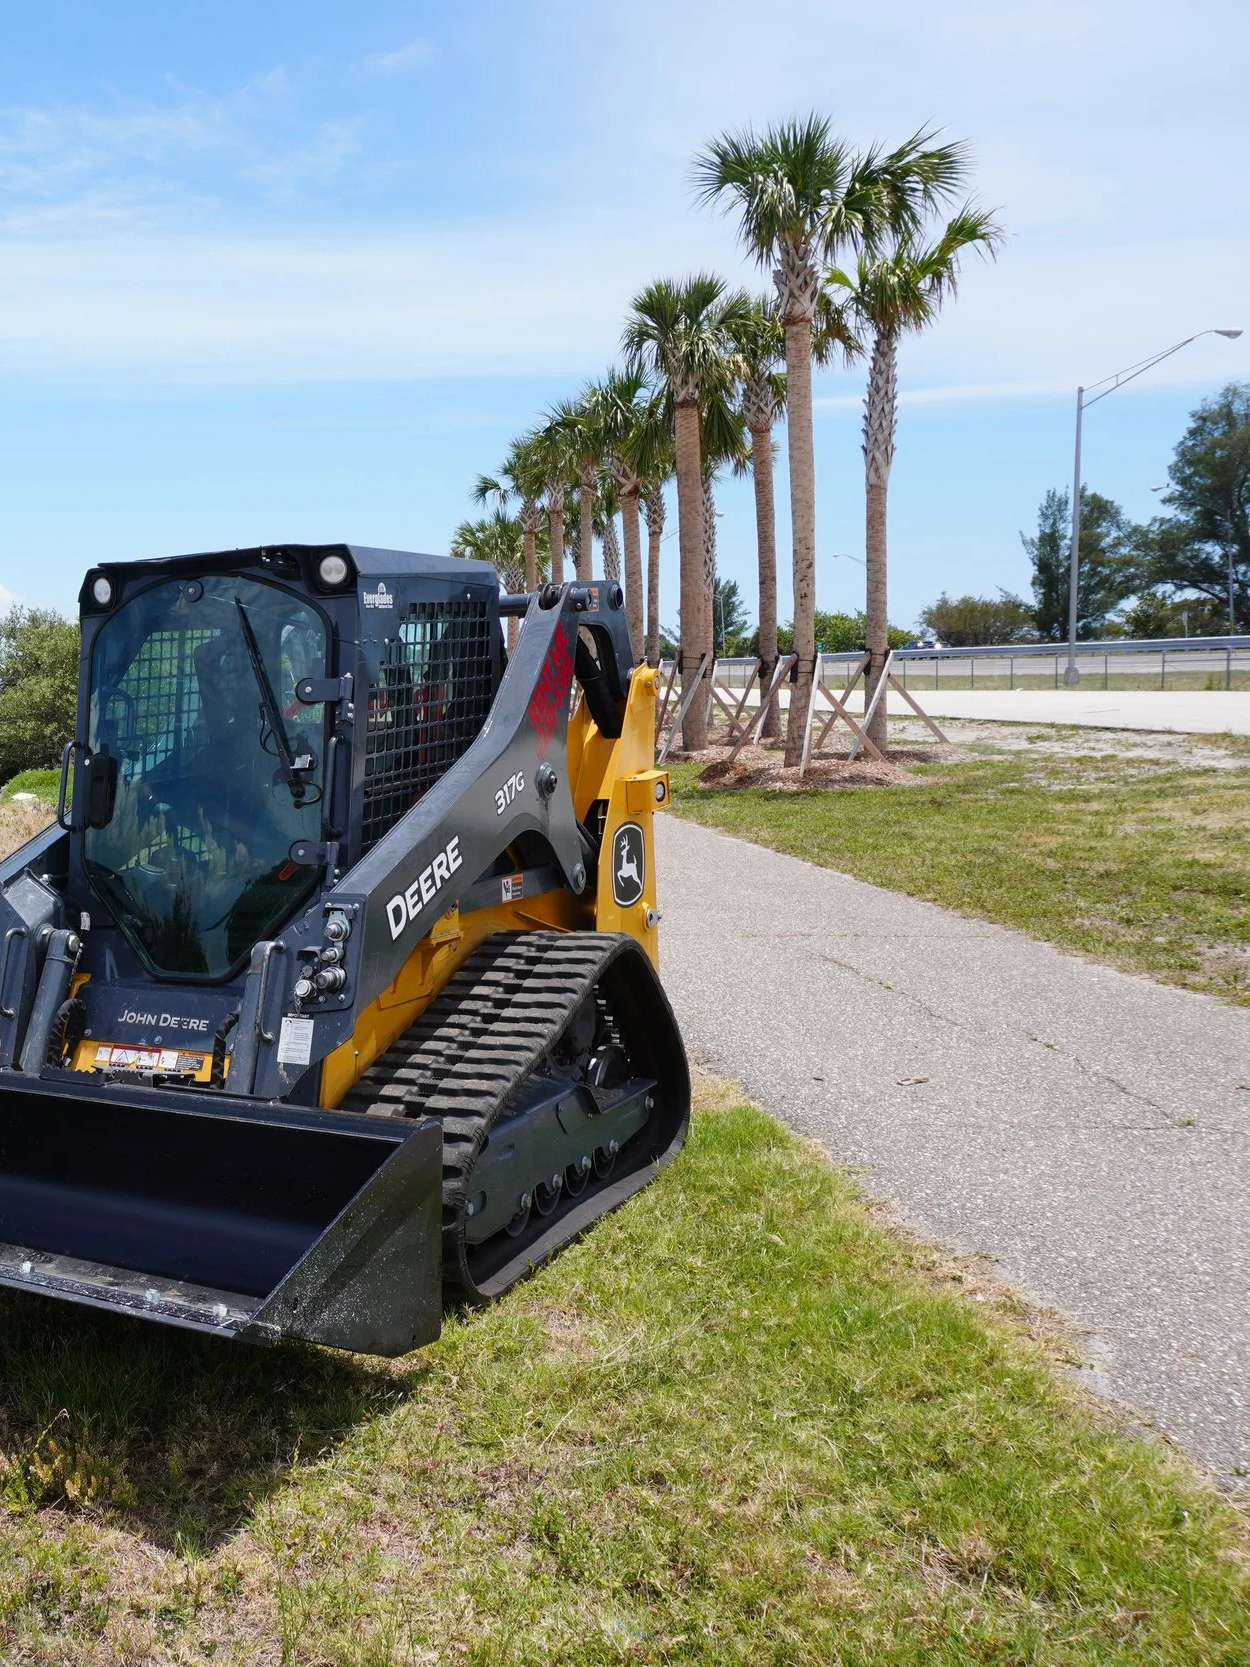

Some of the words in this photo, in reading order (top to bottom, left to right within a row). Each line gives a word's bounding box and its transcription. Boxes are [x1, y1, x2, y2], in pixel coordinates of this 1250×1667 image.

[363, 591, 394, 607] Everglades
[494, 770, 526, 815] 317G
[385, 835, 463, 942] DEERE
[117, 1009, 158, 1027] JOHN
[158, 1013, 210, 1032] DEERE
